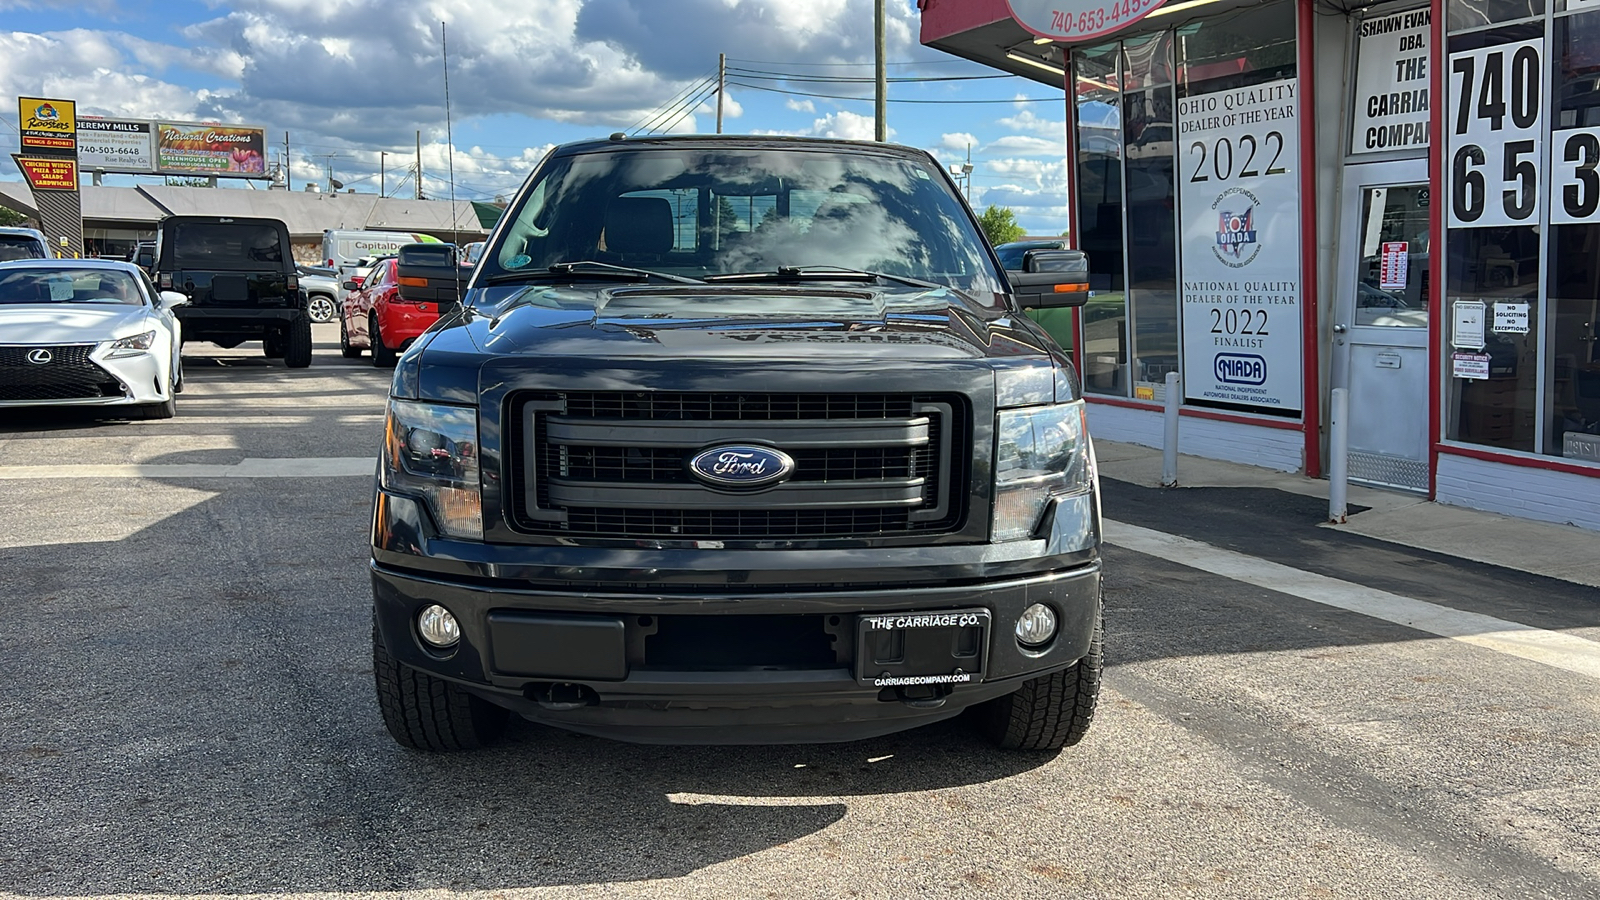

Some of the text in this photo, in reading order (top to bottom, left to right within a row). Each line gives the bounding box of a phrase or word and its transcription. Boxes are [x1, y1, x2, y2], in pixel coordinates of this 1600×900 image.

[1362, 16, 1402, 37] SHAWN
[1400, 34, 1425, 52] DBA.
[1396, 56, 1426, 82] THE
[1180, 84, 1295, 115] OHIO QUALITY
[1453, 46, 1540, 135] 740
[27, 117, 69, 130] Roosters
[77, 122, 111, 130] JEREMY
[1181, 105, 1294, 133] DEALER OF THE YEAR
[164, 130, 251, 143] Natural Creations
[79, 146, 139, 155] 740-503-6648
[1190, 131, 1286, 182] 2022
[1212, 187, 1261, 210] OHIO INDEPENDENT
[1221, 232, 1250, 244] OIADA
[1185, 282, 1296, 293] NATIONAL QUALITY
[1186, 295, 1295, 305] DEALER OF THE YEAR
[1210, 308, 1269, 336] 2022
[1214, 337, 1264, 348] FINALIST
[1218, 359, 1261, 379] NIADA
[713, 452, 766, 474] Ford
[870, 614, 979, 629] THE CARRIAGE CO.
[875, 674, 970, 686] CARRIAGECOMPANY.COM
